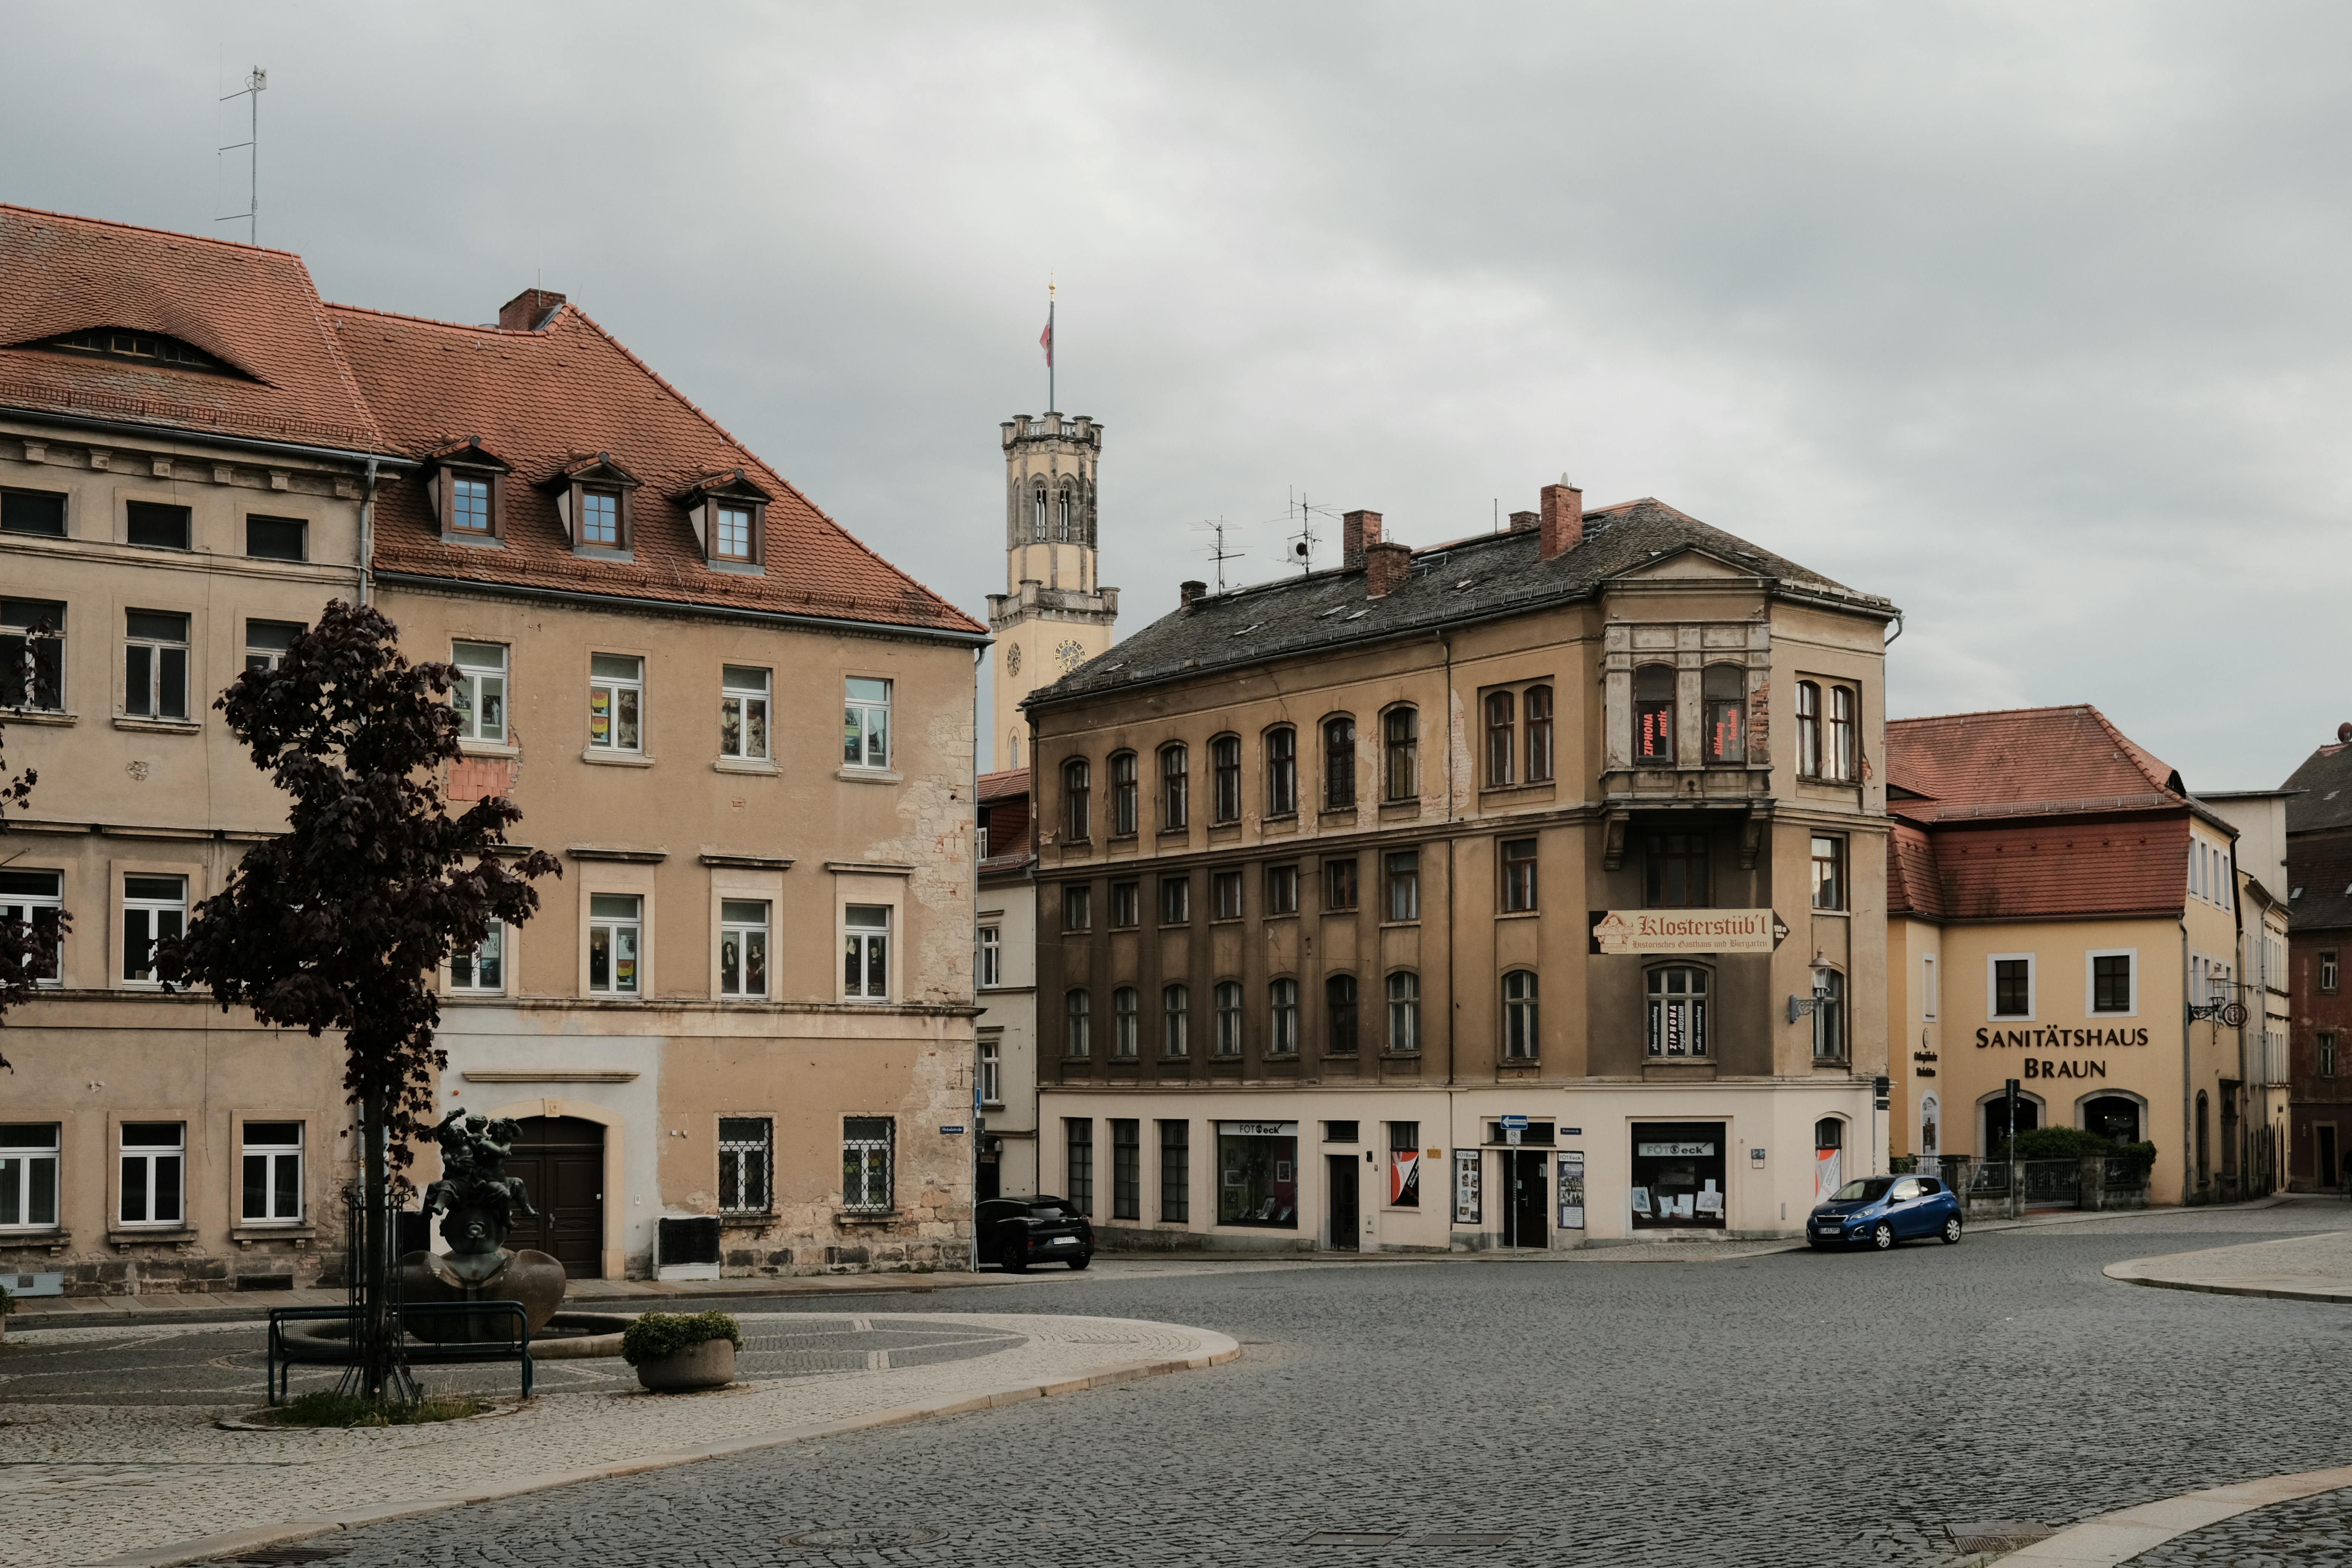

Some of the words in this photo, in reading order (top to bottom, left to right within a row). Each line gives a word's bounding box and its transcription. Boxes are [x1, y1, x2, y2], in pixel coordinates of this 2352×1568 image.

[1644, 714, 1653, 756] ZIPHONA
[1657, 710, 1667, 737] matic
[1728, 709, 1737, 740] Technik
[1714, 722, 1725, 755] Bildung
[1632, 940, 1675, 949] Historisches
[1730, 939, 1767, 948] Biergarten
[1976, 1024, 2148, 1048] SANITÄTSHAUS
[2024, 1058, 2106, 1078] BRAUN
